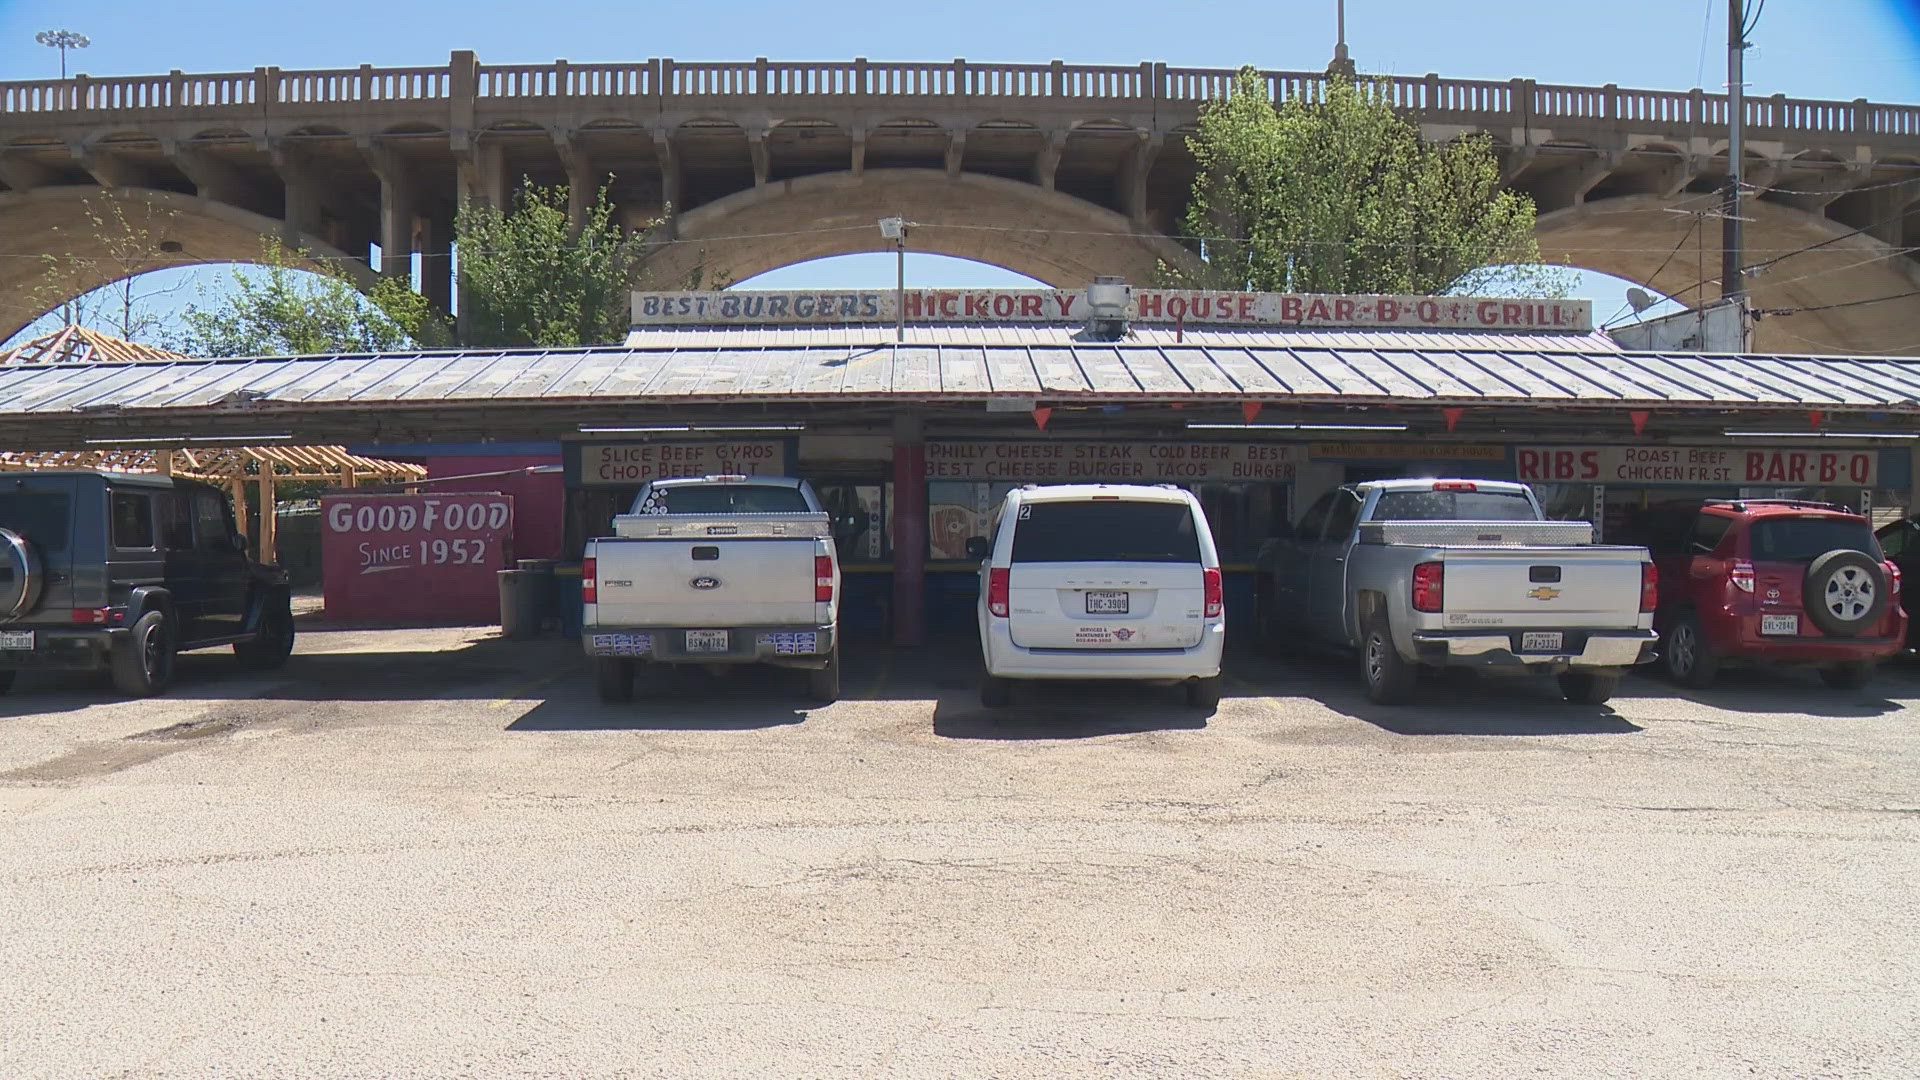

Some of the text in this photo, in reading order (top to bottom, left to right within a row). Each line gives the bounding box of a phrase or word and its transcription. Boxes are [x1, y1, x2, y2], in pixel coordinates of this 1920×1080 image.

[642, 295, 709, 316] BEST
[721, 294, 878, 319] BURGERS
[903, 292, 1076, 317] HICKORY
[1139, 293, 1256, 322] HOUSE
[1477, 301, 1567, 326] GRILL
[602, 445, 774, 463] SLICE BEEF GYROS
[930, 444, 1288, 461] PHILLY CHEESE STEAK COLD BEER BEST
[1625, 448, 1727, 464] ROAST BEEF
[599, 463, 651, 480] CHOP
[658, 462, 704, 477] BEEF
[924, 461, 1297, 478] BEST CHEESE BURGER TACOS BURGER
[1517, 450, 1600, 480] RIBS
[1616, 464, 1684, 480] CHICKEN
[328, 500, 510, 533] GOOD FOOD
[1020, 506, 1029, 519] 2
[715, 527, 738, 535] HUSKY
[420, 539, 487, 566] 1952
